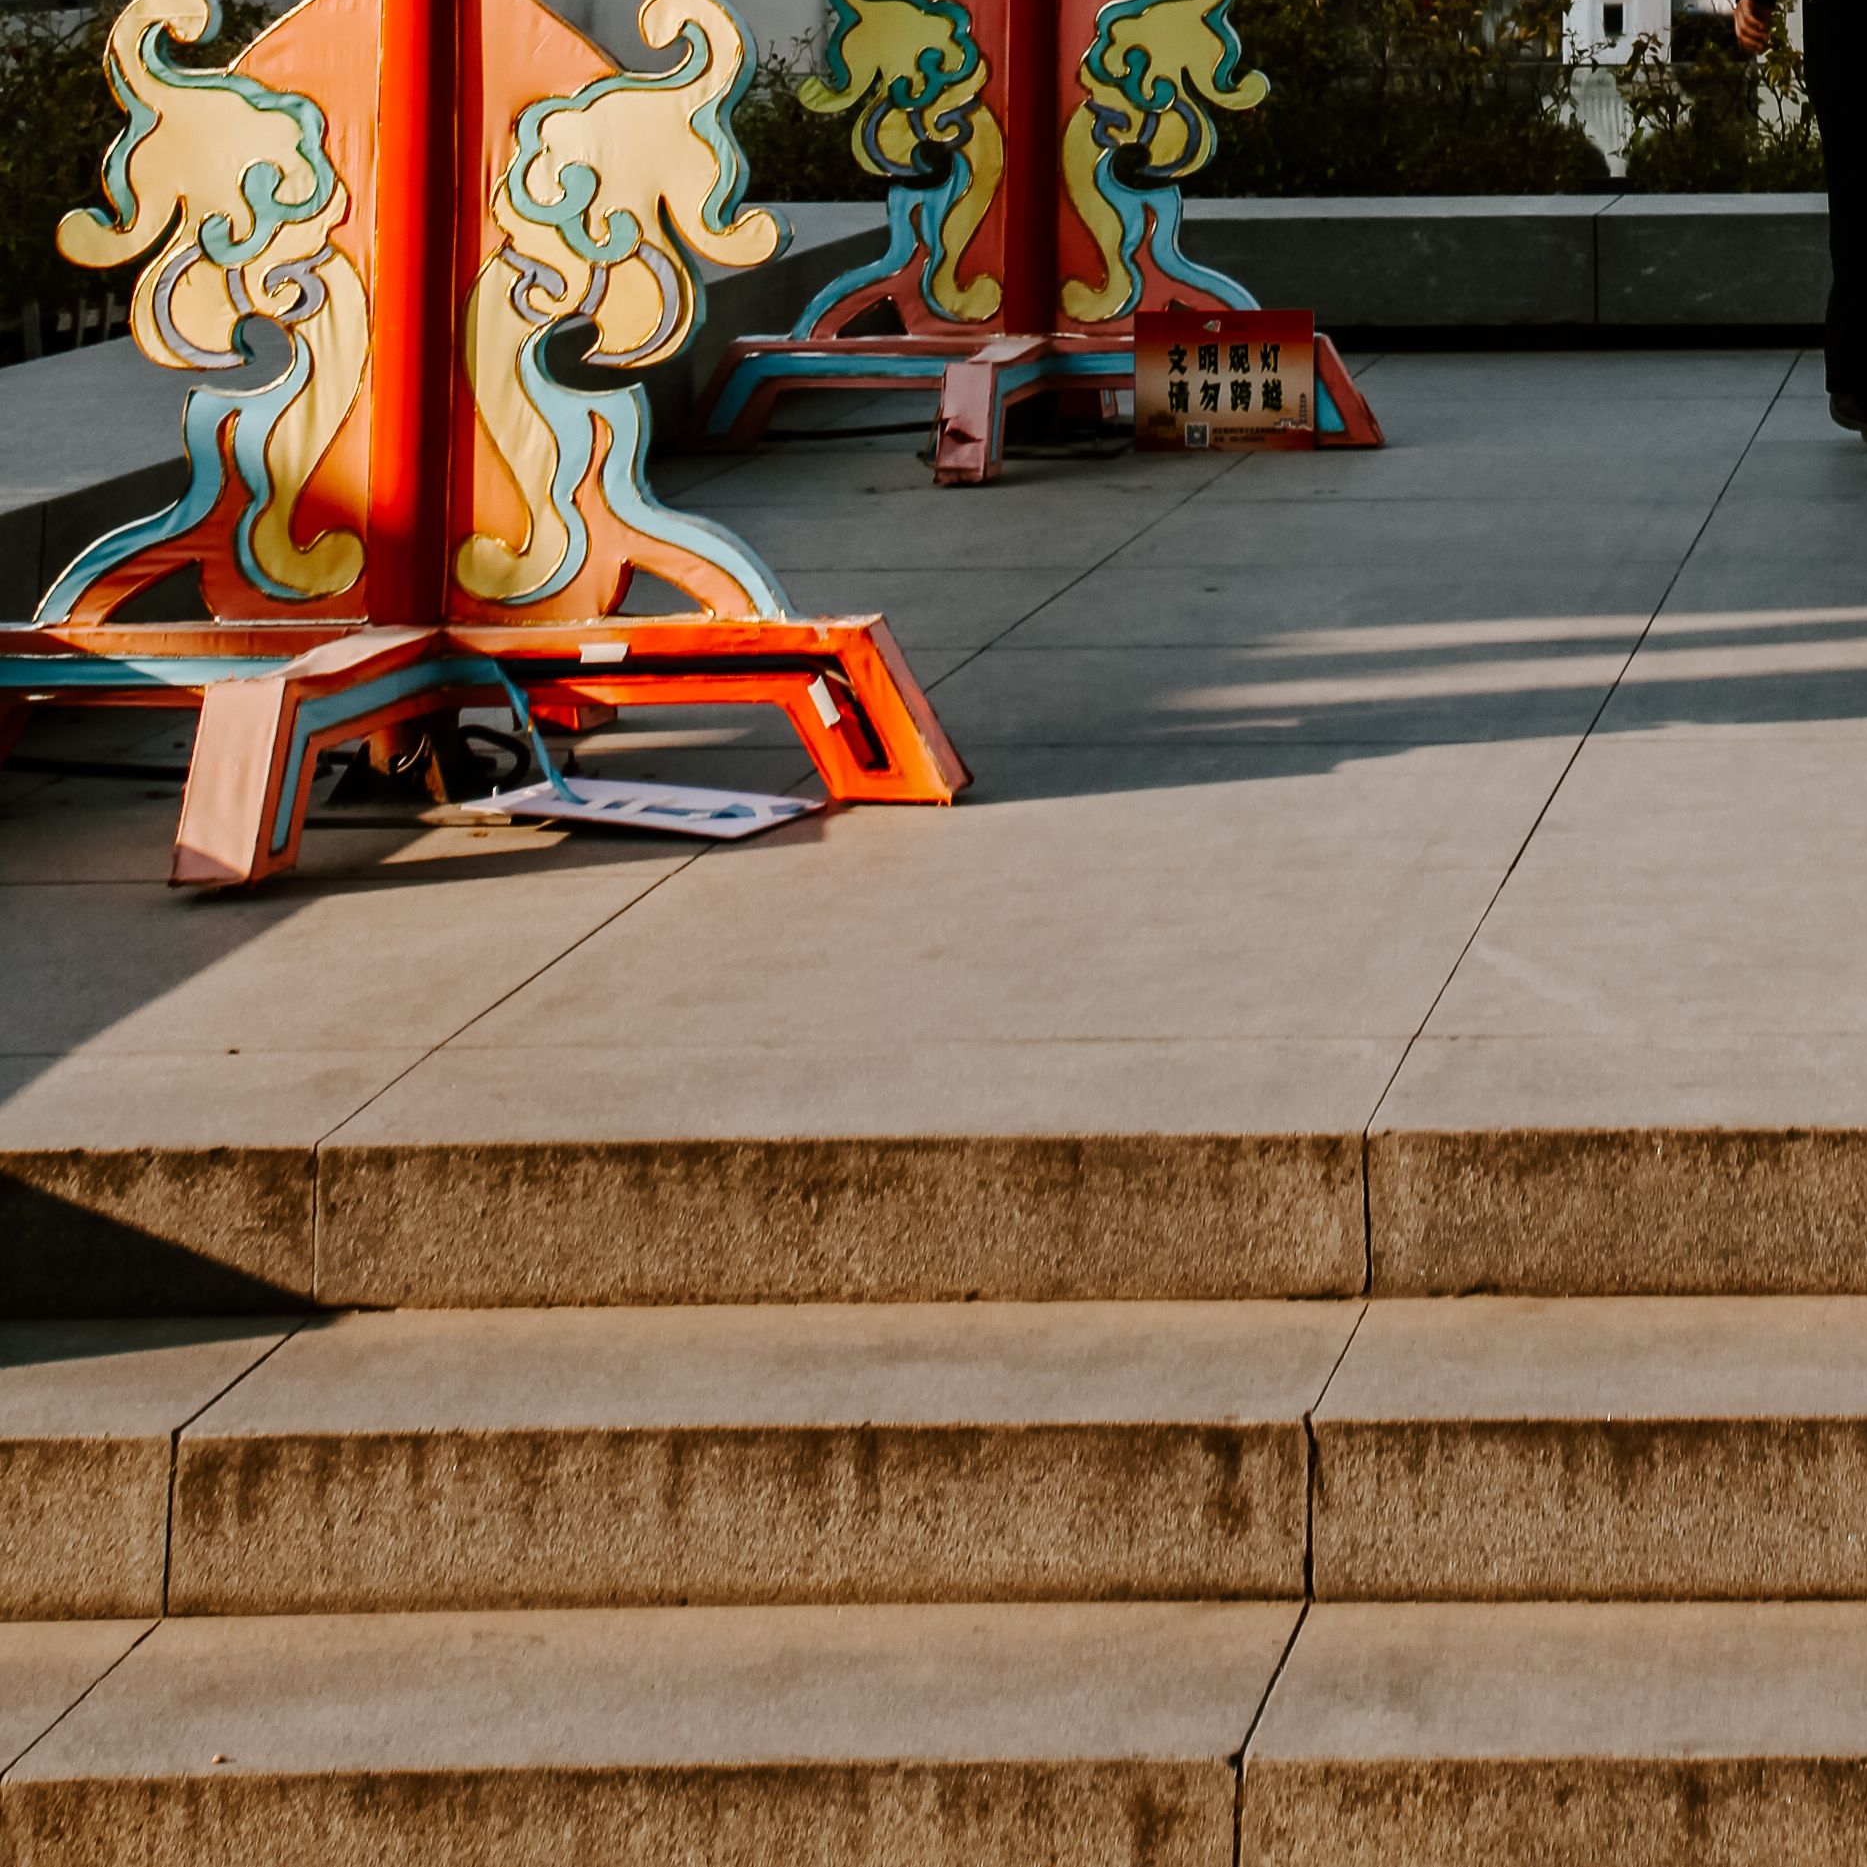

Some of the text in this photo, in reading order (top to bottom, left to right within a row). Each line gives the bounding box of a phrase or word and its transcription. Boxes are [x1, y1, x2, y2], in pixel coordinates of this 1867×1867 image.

[1167, 343, 1281, 375] 文明观灯
[1168, 379, 1283, 414] 请勿跨越
